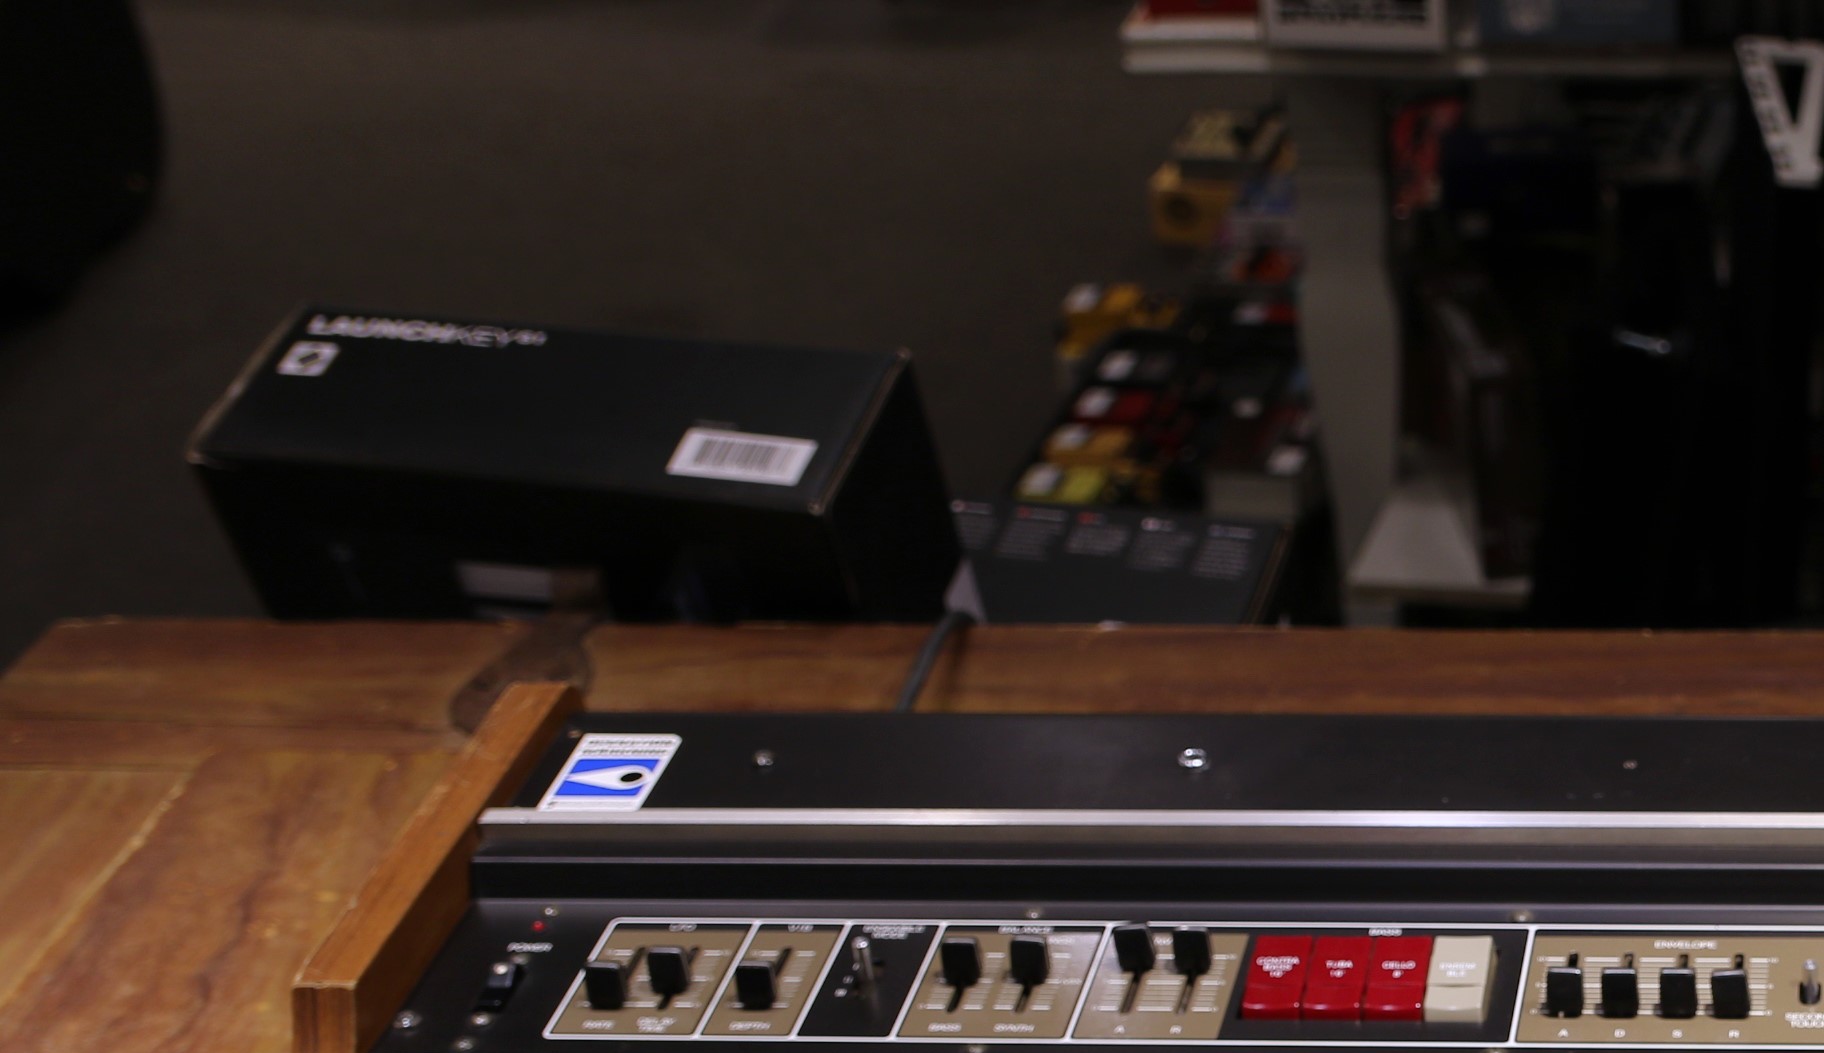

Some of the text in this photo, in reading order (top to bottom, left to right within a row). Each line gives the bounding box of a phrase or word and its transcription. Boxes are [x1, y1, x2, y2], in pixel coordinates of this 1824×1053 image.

[306, 313, 518, 348] LAUNCHKEY
[1653, 940, 1718, 950] ENVELOPE
[1557, 1027, 1570, 1039] A
[1613, 1027, 1627, 1039] D
